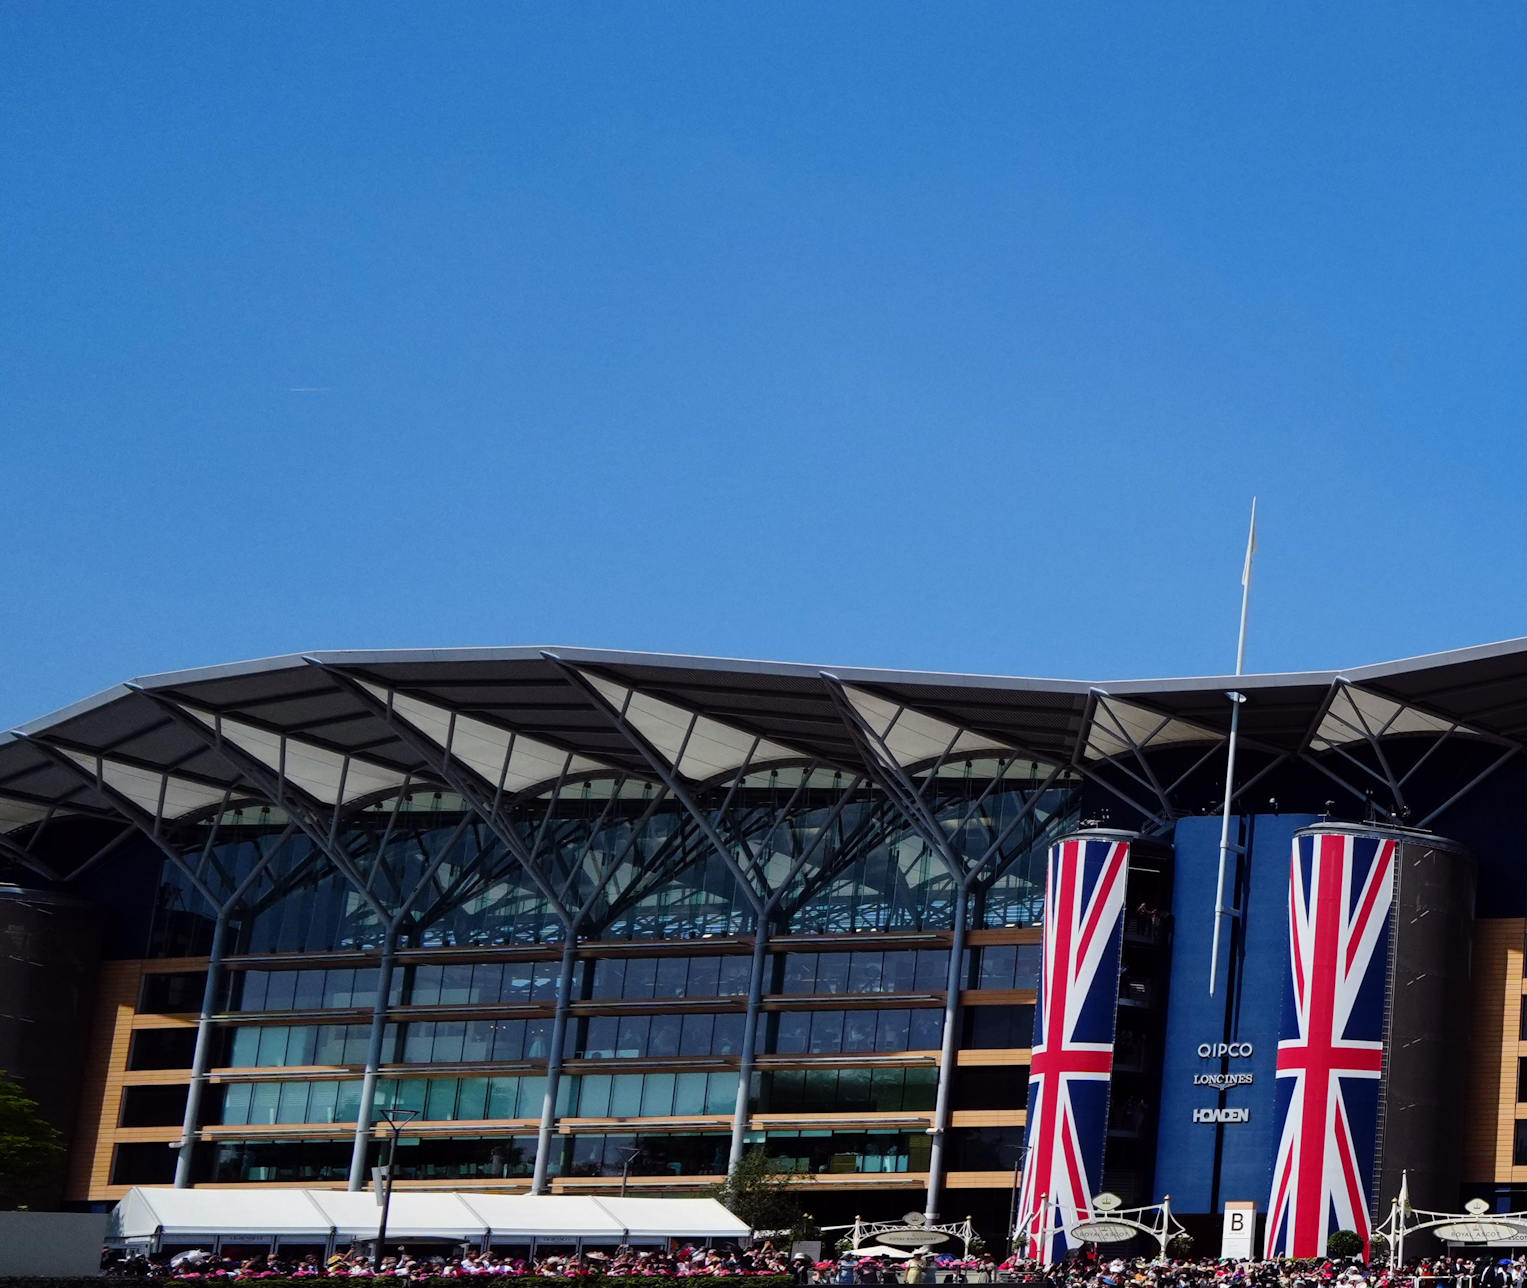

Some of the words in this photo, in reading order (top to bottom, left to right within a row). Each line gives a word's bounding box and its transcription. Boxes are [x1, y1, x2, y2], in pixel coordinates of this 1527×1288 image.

[1197, 1043, 1253, 1058] QIPCO
[1193, 1073, 1253, 1085] LONGINES
[1192, 1108, 1250, 1122] HOWDEN
[1231, 1213, 1244, 1231] B
